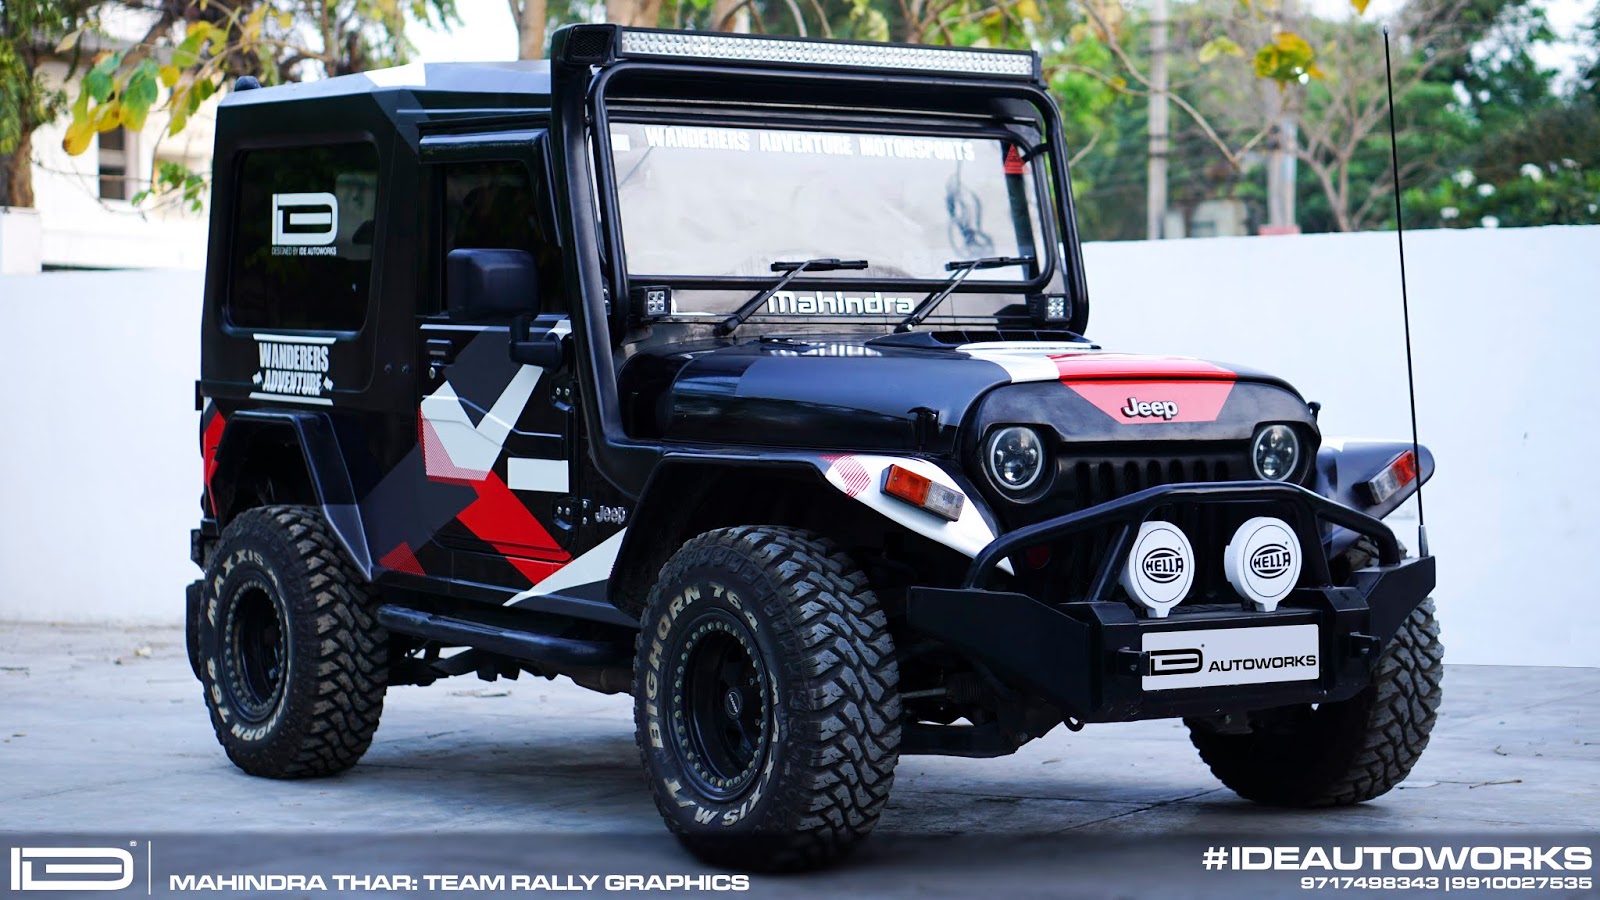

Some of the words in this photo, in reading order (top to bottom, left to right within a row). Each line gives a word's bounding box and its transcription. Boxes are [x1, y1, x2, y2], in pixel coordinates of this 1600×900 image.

[645, 127, 750, 151] WANDERERS
[759, 132, 853, 156] ADVENTURE
[859, 136, 975, 161] MOTORSPORTS
[308, 246, 337, 255] AUTOWORKS
[768, 291, 915, 315] Mahindra
[259, 342, 329, 373] WANDERERS
[262, 369, 322, 396] ADVENTURE
[1122, 397, 1178, 419] Jeep
[594, 505, 626, 525] Jeep
[1145, 556, 1184, 573] HELLA
[1253, 551, 1291, 568] HELLA
[207, 549, 264, 629] MAXXIS
[646, 585, 701, 749] BIGHORN
[709, 581, 758, 632] 764
[1208, 655, 1317, 673] AUTOWORKS
